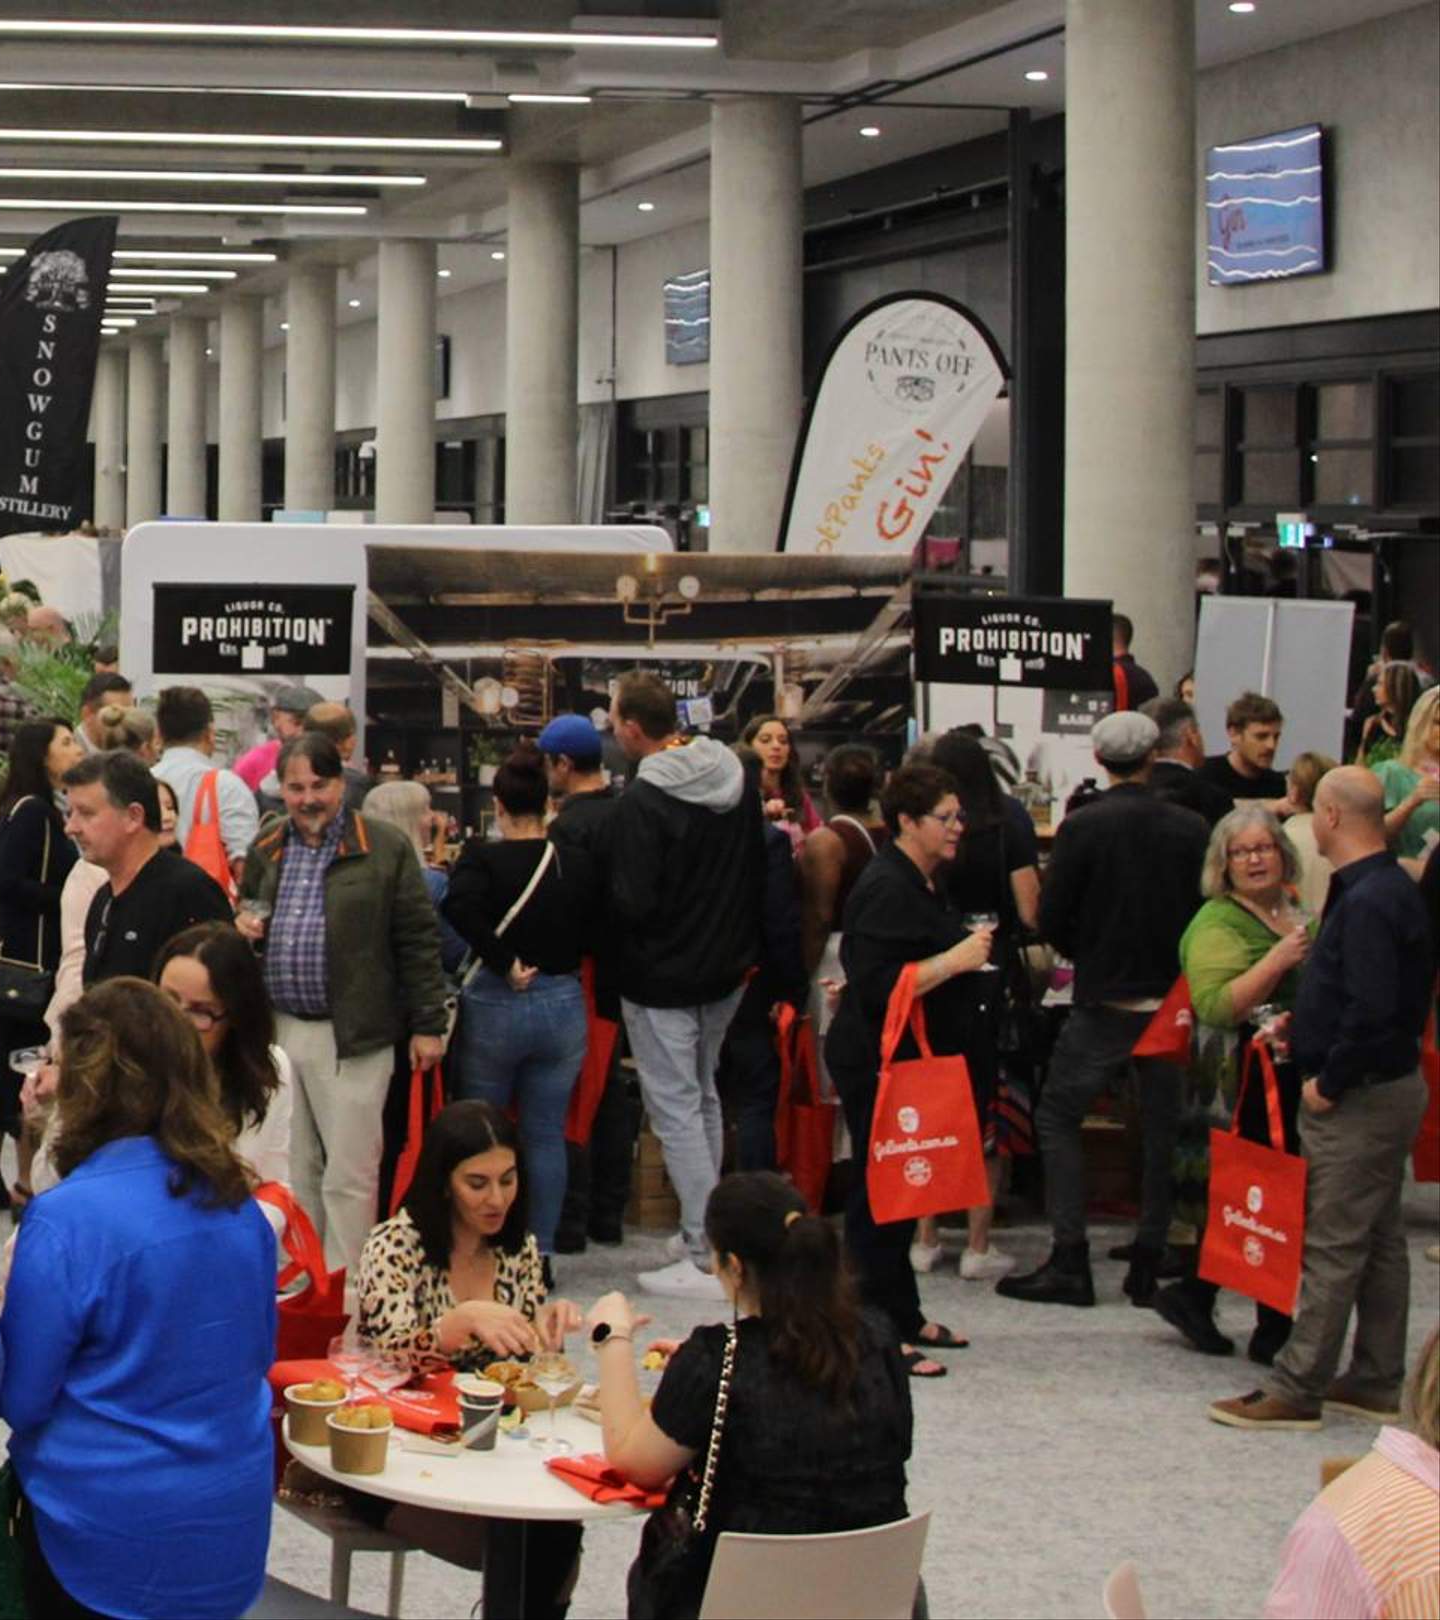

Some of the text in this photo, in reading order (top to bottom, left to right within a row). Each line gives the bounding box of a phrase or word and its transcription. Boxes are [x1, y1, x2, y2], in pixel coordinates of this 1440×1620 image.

[865, 342, 978, 377] PANTS OFF
[19, 314, 57, 495] SNOWGUM
[816, 442, 887, 553] otPants
[875, 428, 950, 542] Gin!
[224, 600, 285, 614] LIQUOR CO.
[981, 613, 1042, 627] LIQUOR CO.
[182, 616, 326, 646] PROHIBITION
[939, 627, 1084, 661] PROHIBITION
